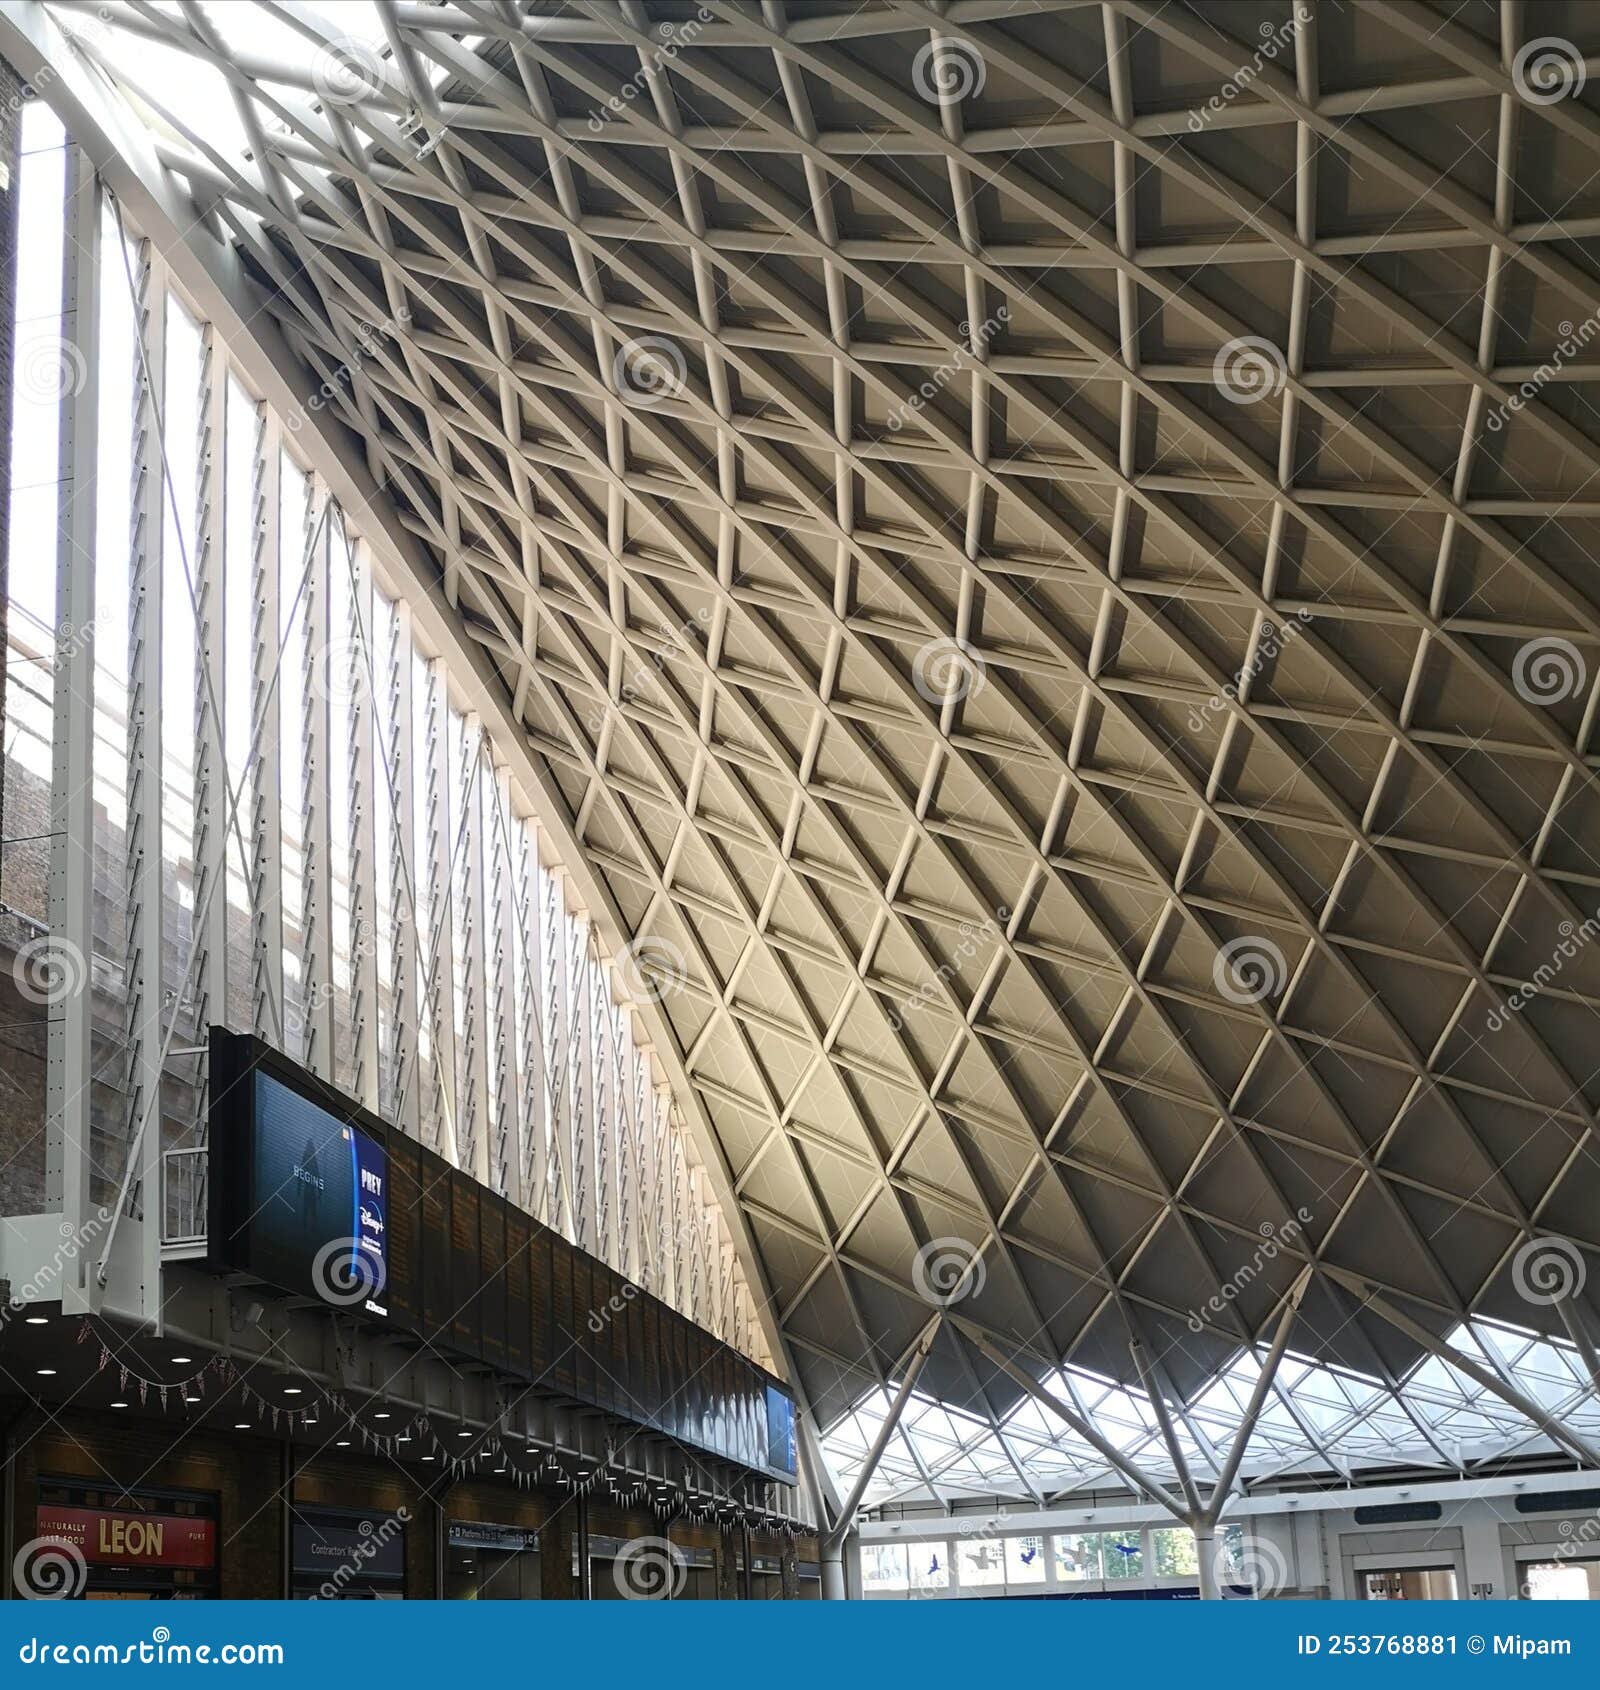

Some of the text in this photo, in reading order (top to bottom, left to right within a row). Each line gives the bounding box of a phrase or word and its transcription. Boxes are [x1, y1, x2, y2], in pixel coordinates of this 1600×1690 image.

[293, 1165, 324, 1190] BEGINS
[361, 1168, 382, 1196] PREY
[40, 1521, 86, 1532] NATURALLY
[99, 1519, 163, 1556] LEON
[63, 1535, 85, 1545] FOOD
